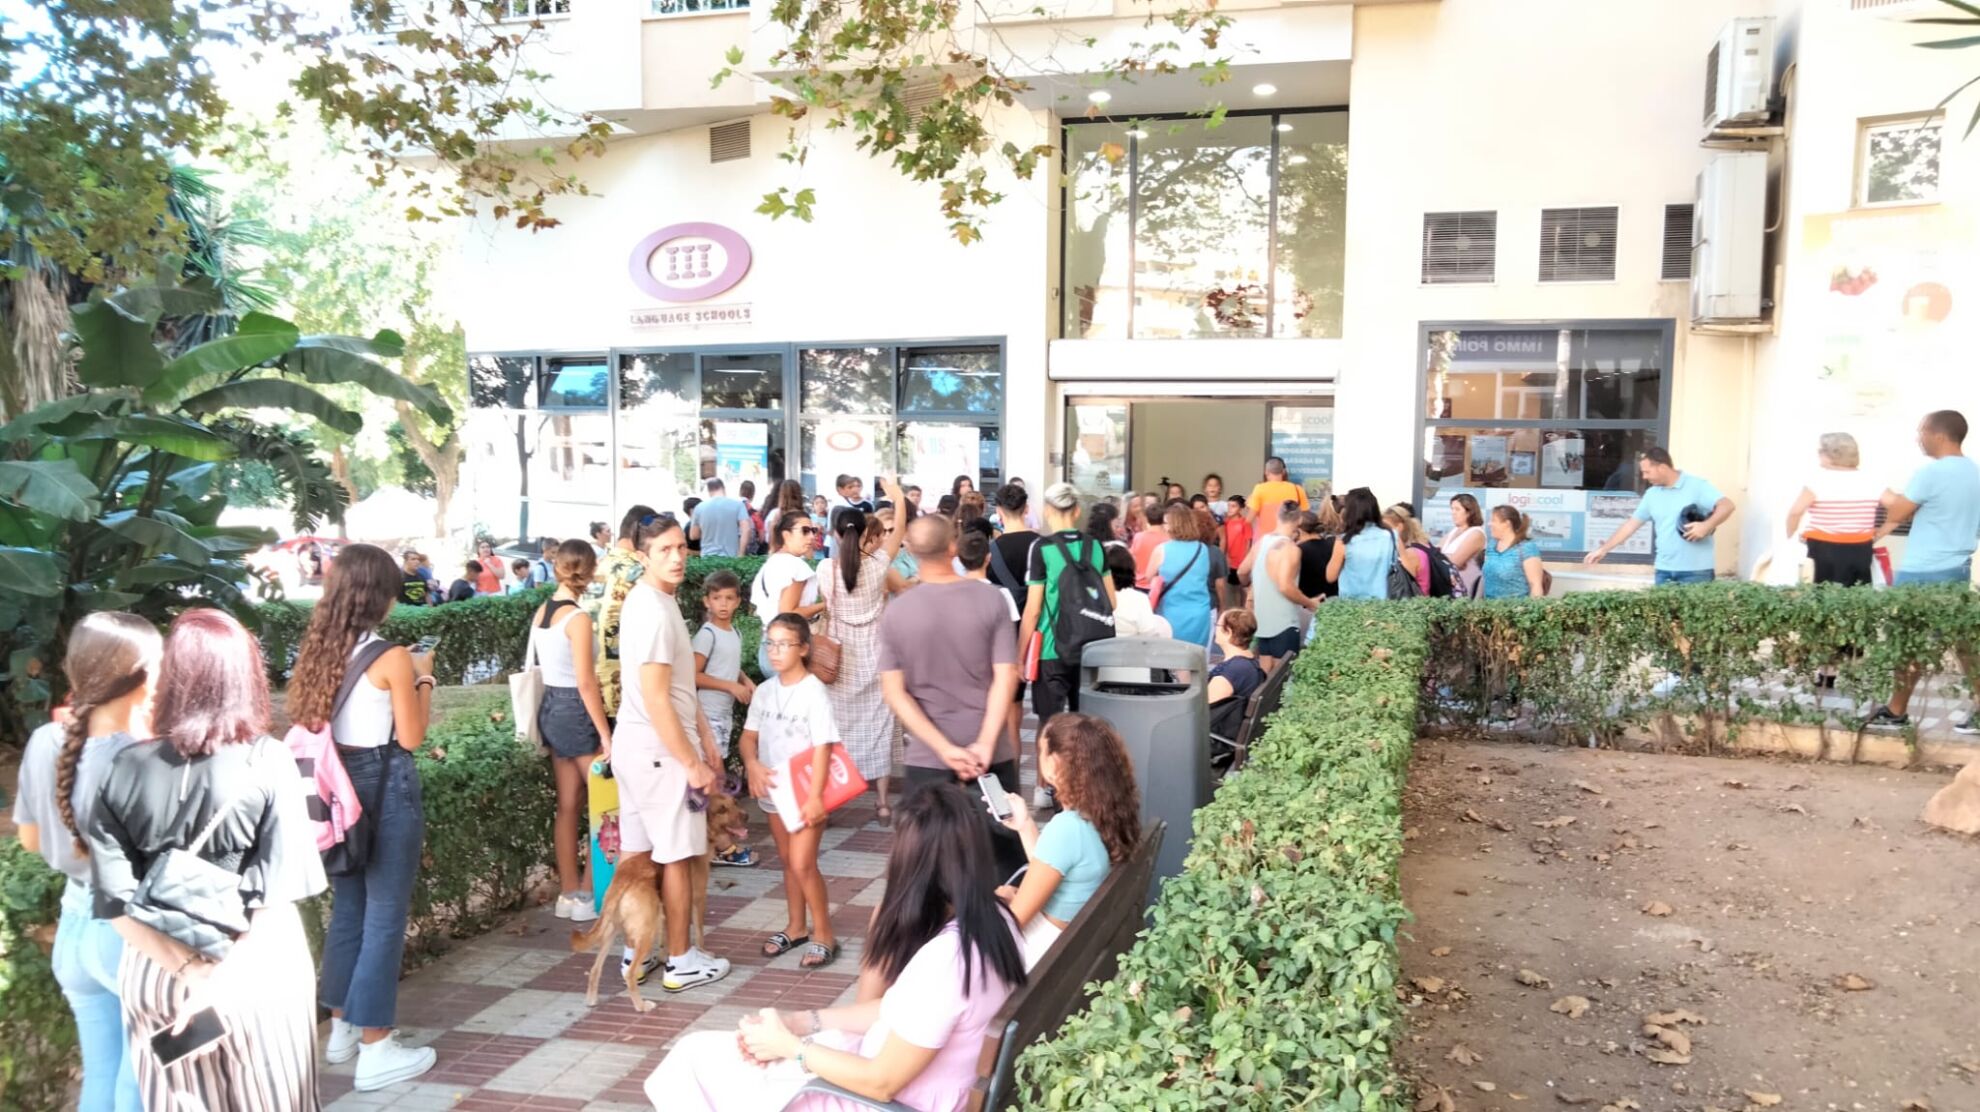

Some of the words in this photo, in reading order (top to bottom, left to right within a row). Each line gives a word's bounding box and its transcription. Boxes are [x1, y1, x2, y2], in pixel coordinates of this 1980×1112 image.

[630, 312, 691, 325] LANGUAGE
[695, 309, 751, 322] SCHOOLS
[1508, 493, 1563, 508] logicool
